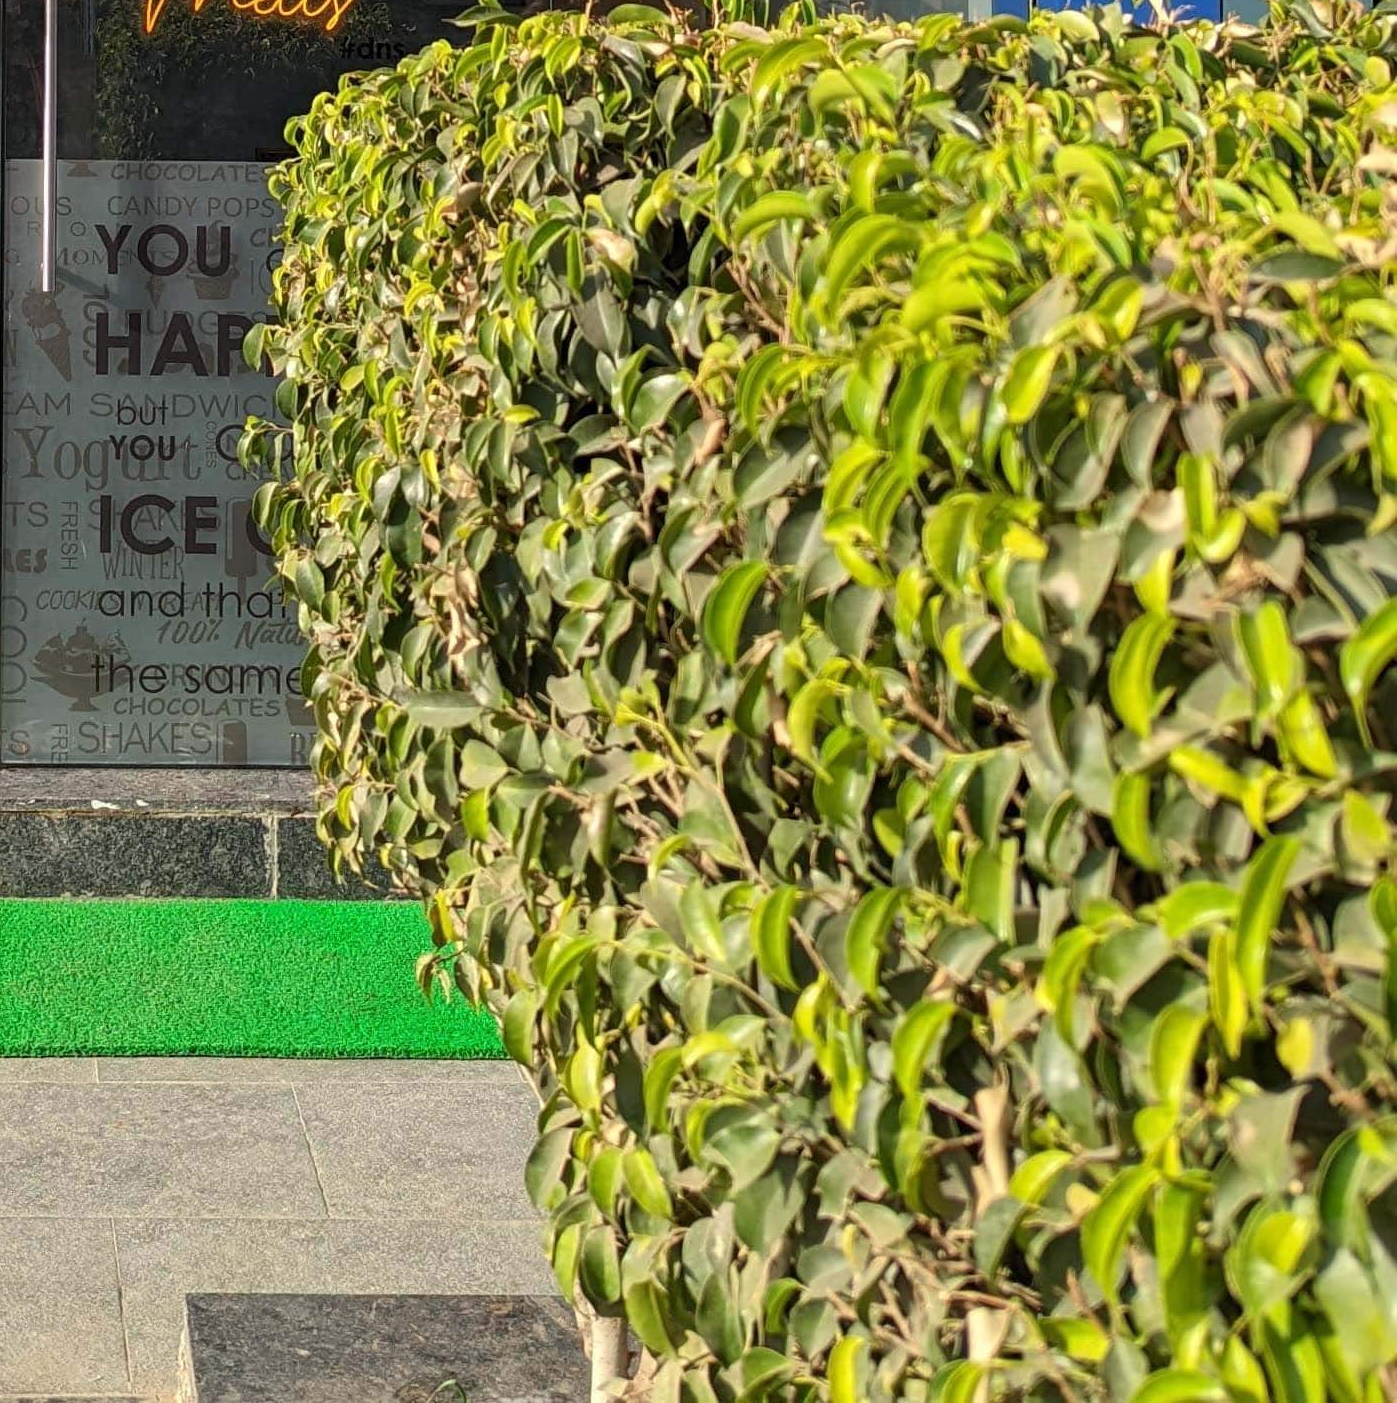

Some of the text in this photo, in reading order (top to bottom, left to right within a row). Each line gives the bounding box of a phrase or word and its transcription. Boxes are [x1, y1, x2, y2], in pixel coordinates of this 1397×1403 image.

[107, 197, 276, 218] CANDY POPS
[94, 224, 231, 277] YOU
[117, 399, 168, 426] but
[109, 434, 177, 461] YOU
[59, 501, 79, 570] FRESH
[100, 494, 218, 555] ICE
[98, 581, 186, 618] and
[156, 618, 308, 650] 100% Natu
[90, 653, 168, 694] the
[112, 696, 282, 718] CHOCOLATES
[78, 721, 213, 755] SHAKES
